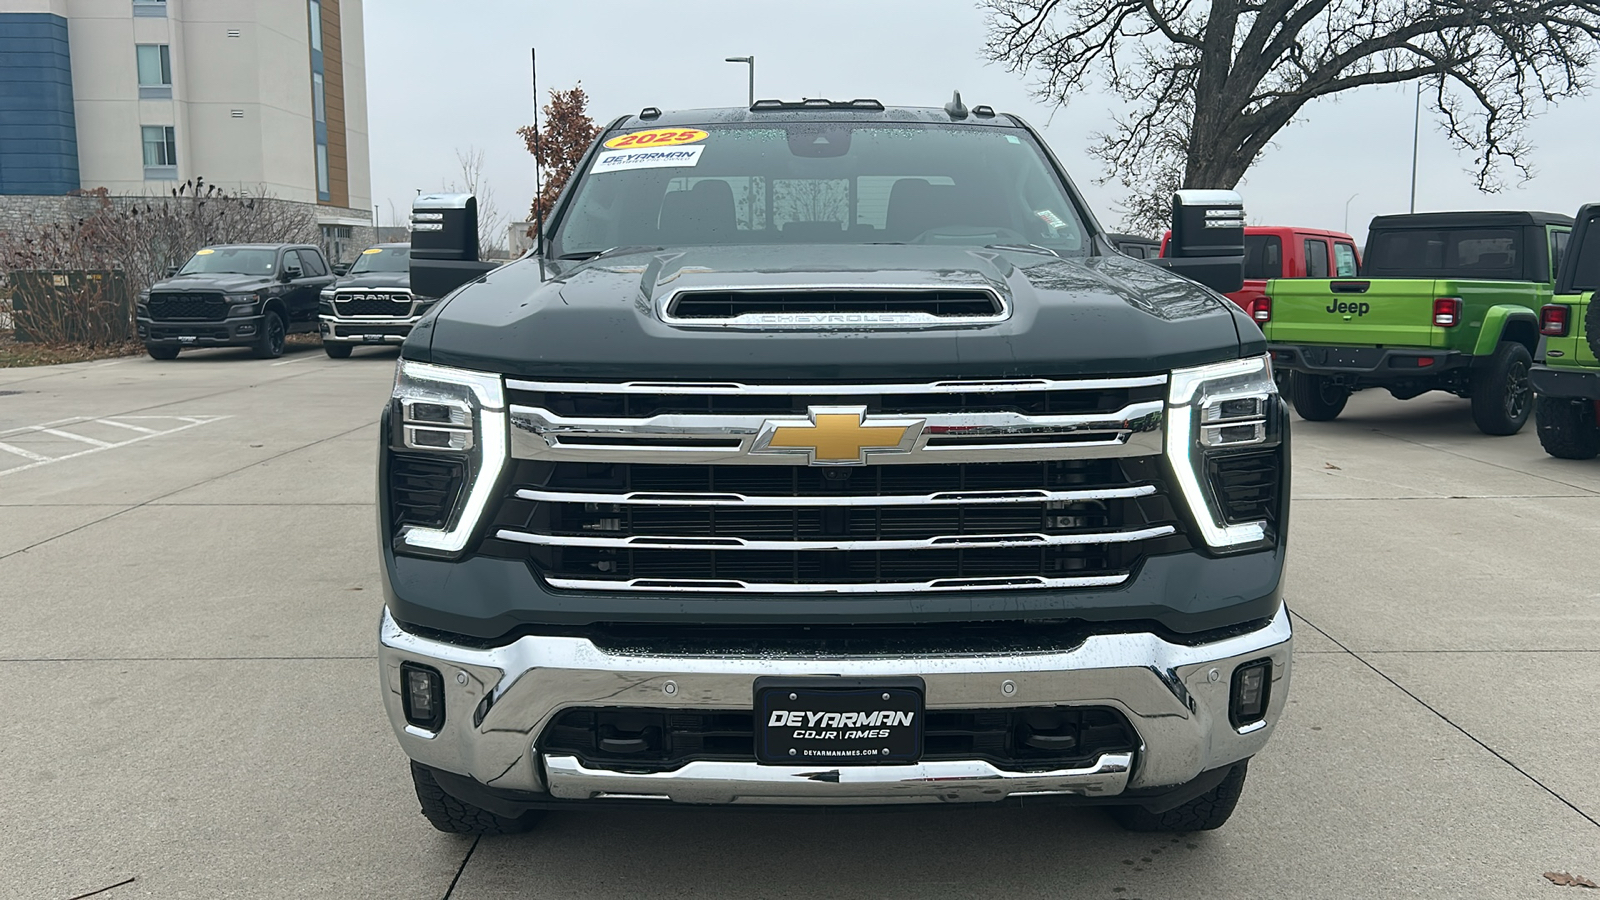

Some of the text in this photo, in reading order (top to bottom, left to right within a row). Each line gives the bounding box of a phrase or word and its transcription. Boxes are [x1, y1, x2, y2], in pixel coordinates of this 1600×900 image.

[614, 131, 699, 147] 2025
[602, 151, 697, 164] DEYARMAN
[1326, 298, 1370, 317] Jeep
[761, 315, 910, 323] CHEVROLET
[768, 711, 914, 728] DEYARMAN
[793, 729, 890, 739] CDJR AMES
